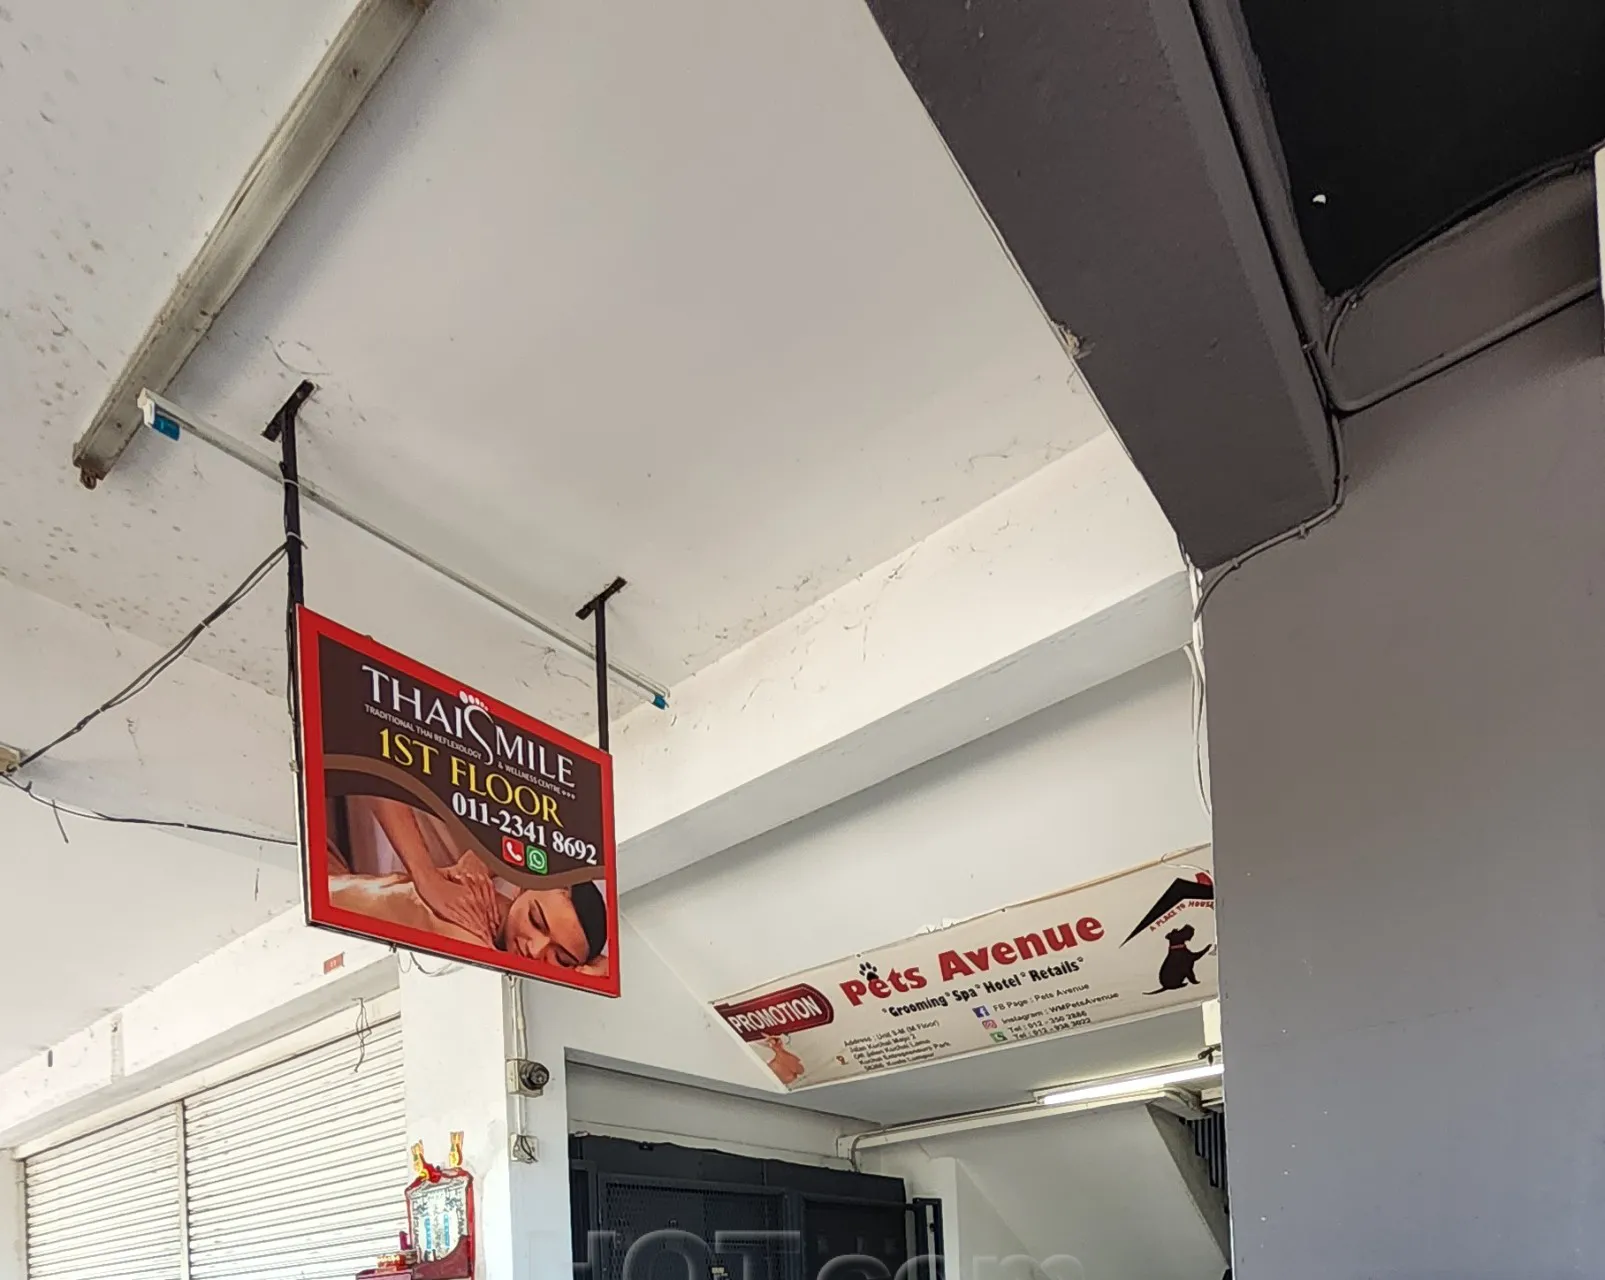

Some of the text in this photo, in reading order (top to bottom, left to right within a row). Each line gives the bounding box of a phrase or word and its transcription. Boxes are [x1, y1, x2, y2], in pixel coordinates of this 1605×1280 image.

[364, 703, 415, 732] TRADITIONAL
[416, 725, 433, 739] THAI
[434, 733, 481, 760] REFLEXOLOGY
[505, 765, 538, 784] WELLNESS
[538, 778, 562, 794] CENTRE
[380, 728, 564, 828] 1ST FLOOR
[452, 792, 597, 865] 011-2341 8692
[839, 916, 1105, 1007] Pets Avenue
[889, 960, 1081, 1018] Grooming Spa Hotel Retails
[992, 1003, 1005, 1012] FB
[1006, 999, 1028, 1008] Page
[1034, 992, 1054, 1001] Pets
[1056, 983, 1090, 996] Avenue
[727, 995, 822, 1034] PROMOTION
